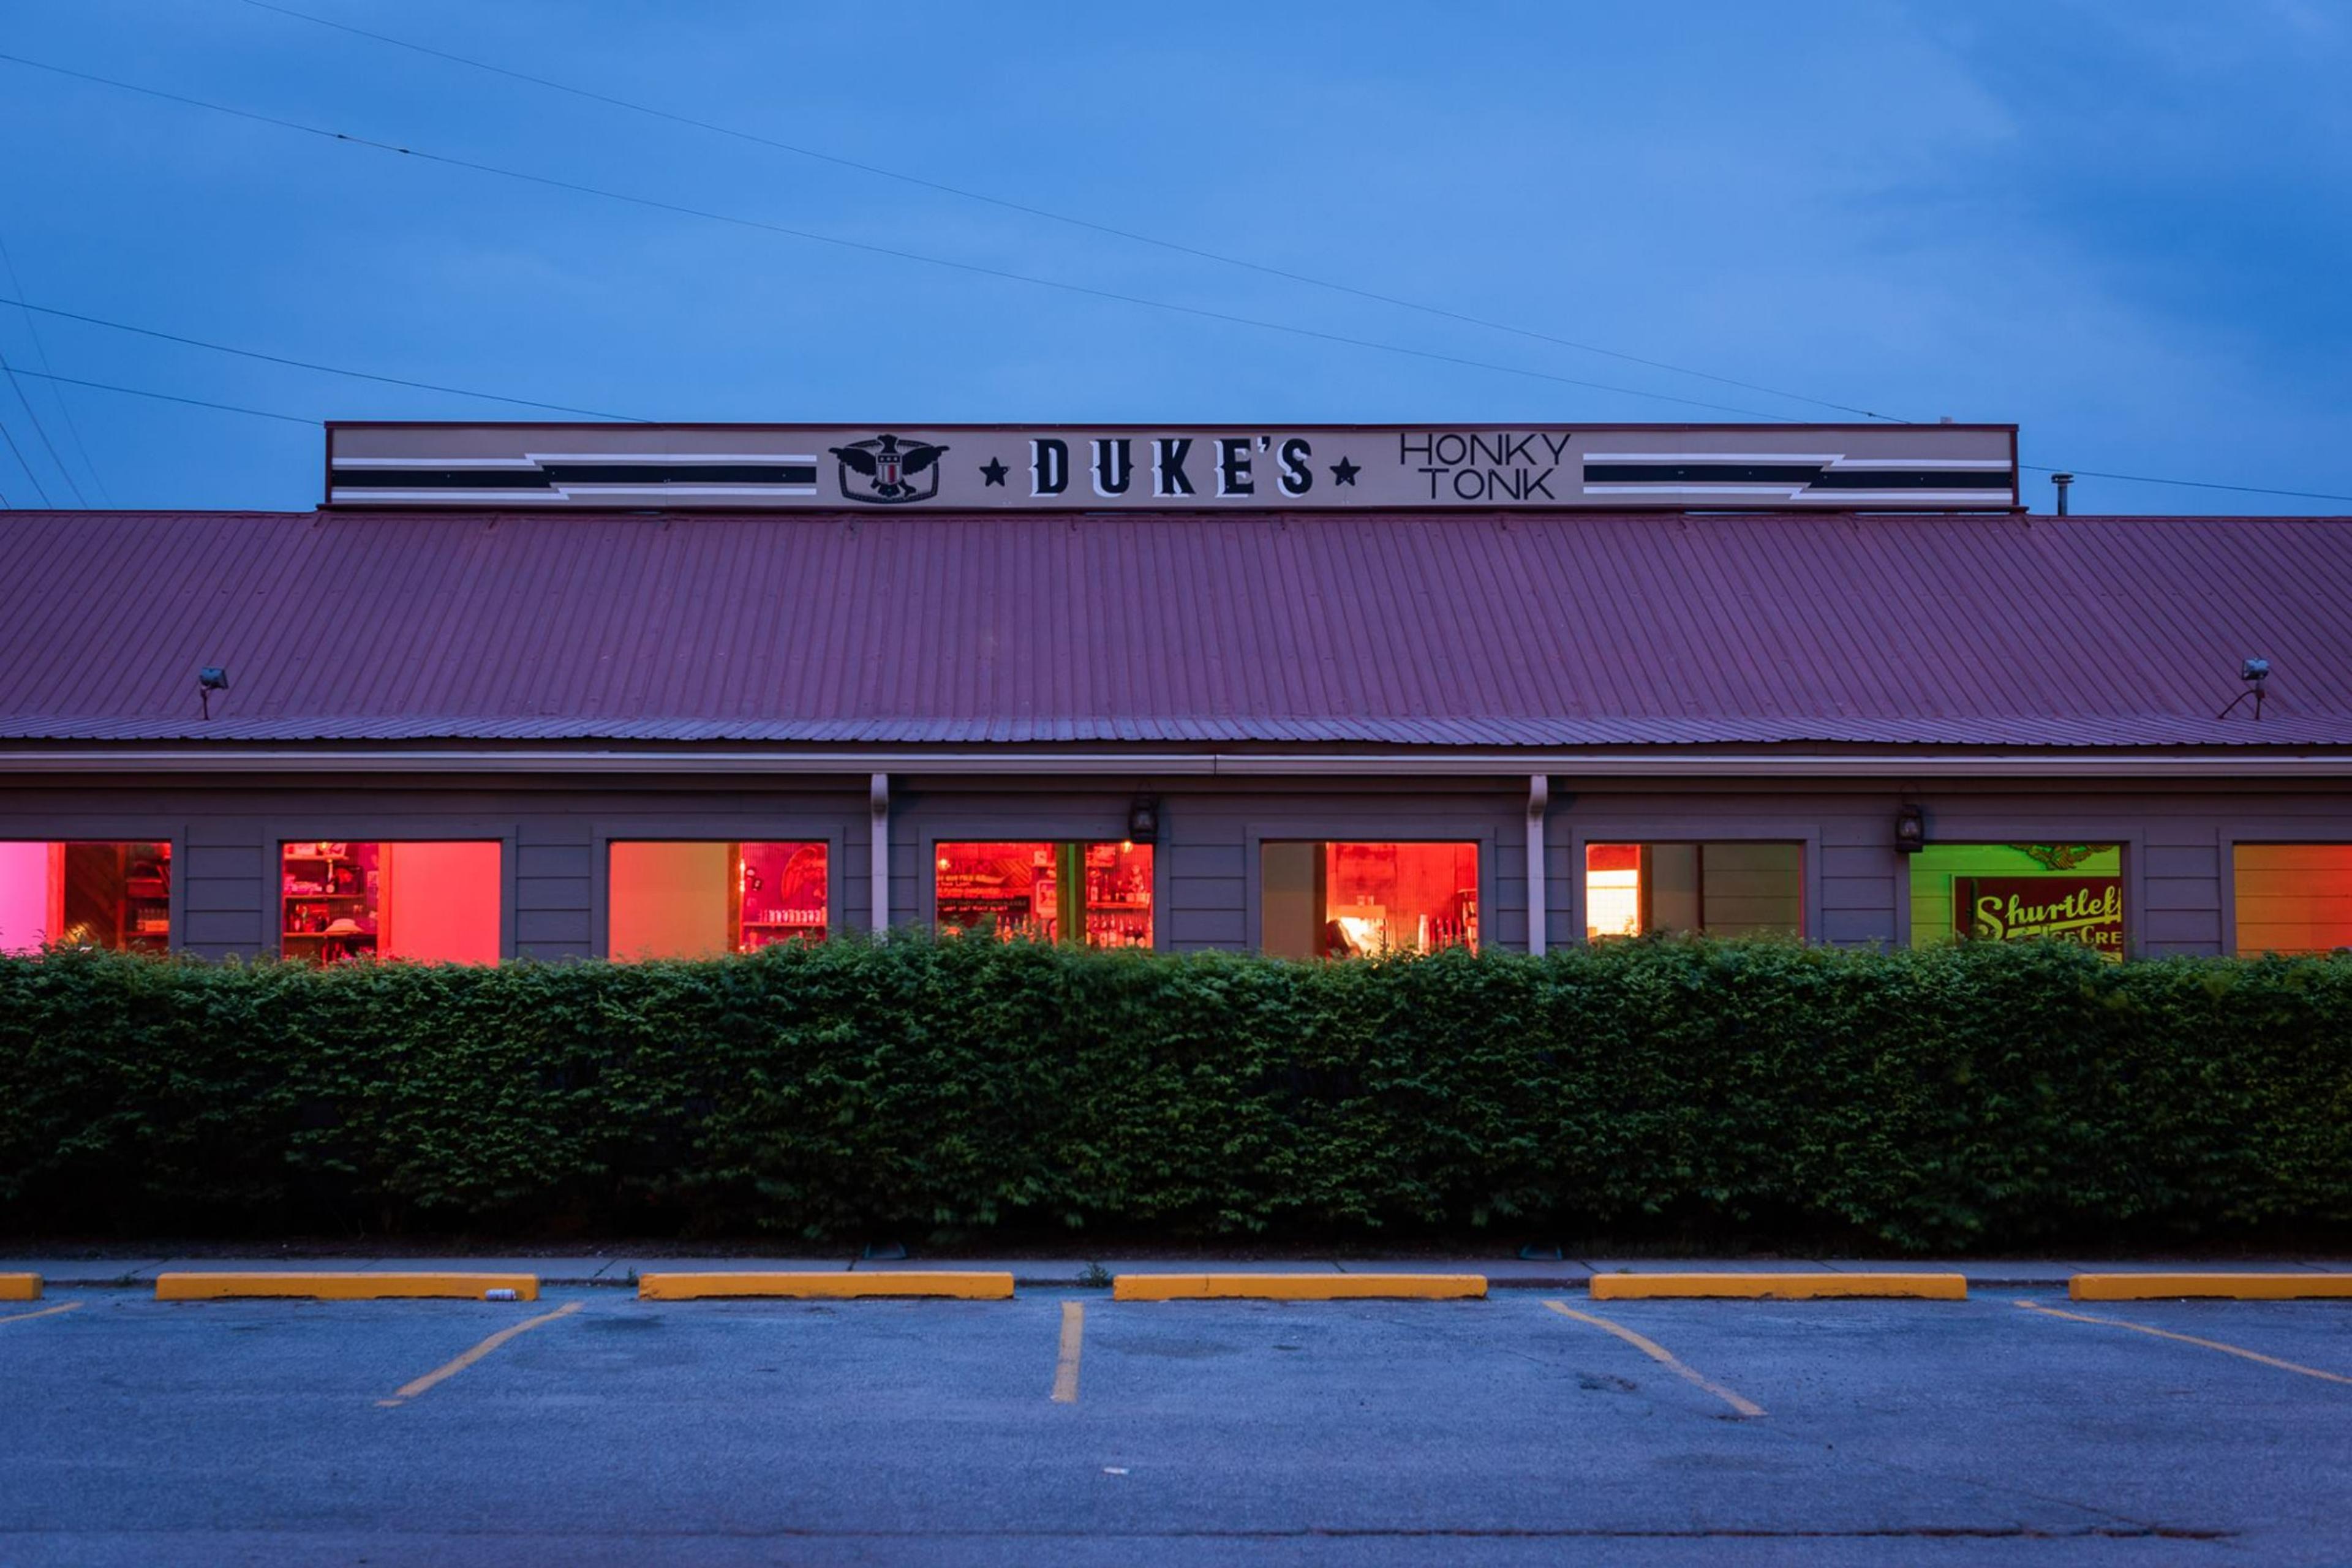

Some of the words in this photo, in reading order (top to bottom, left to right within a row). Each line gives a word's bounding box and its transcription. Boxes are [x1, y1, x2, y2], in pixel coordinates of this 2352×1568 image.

[1400, 433, 1570, 466] HONKY
[1028, 435, 1313, 498] DUKE'S
[1418, 468, 1556, 500] TONK
